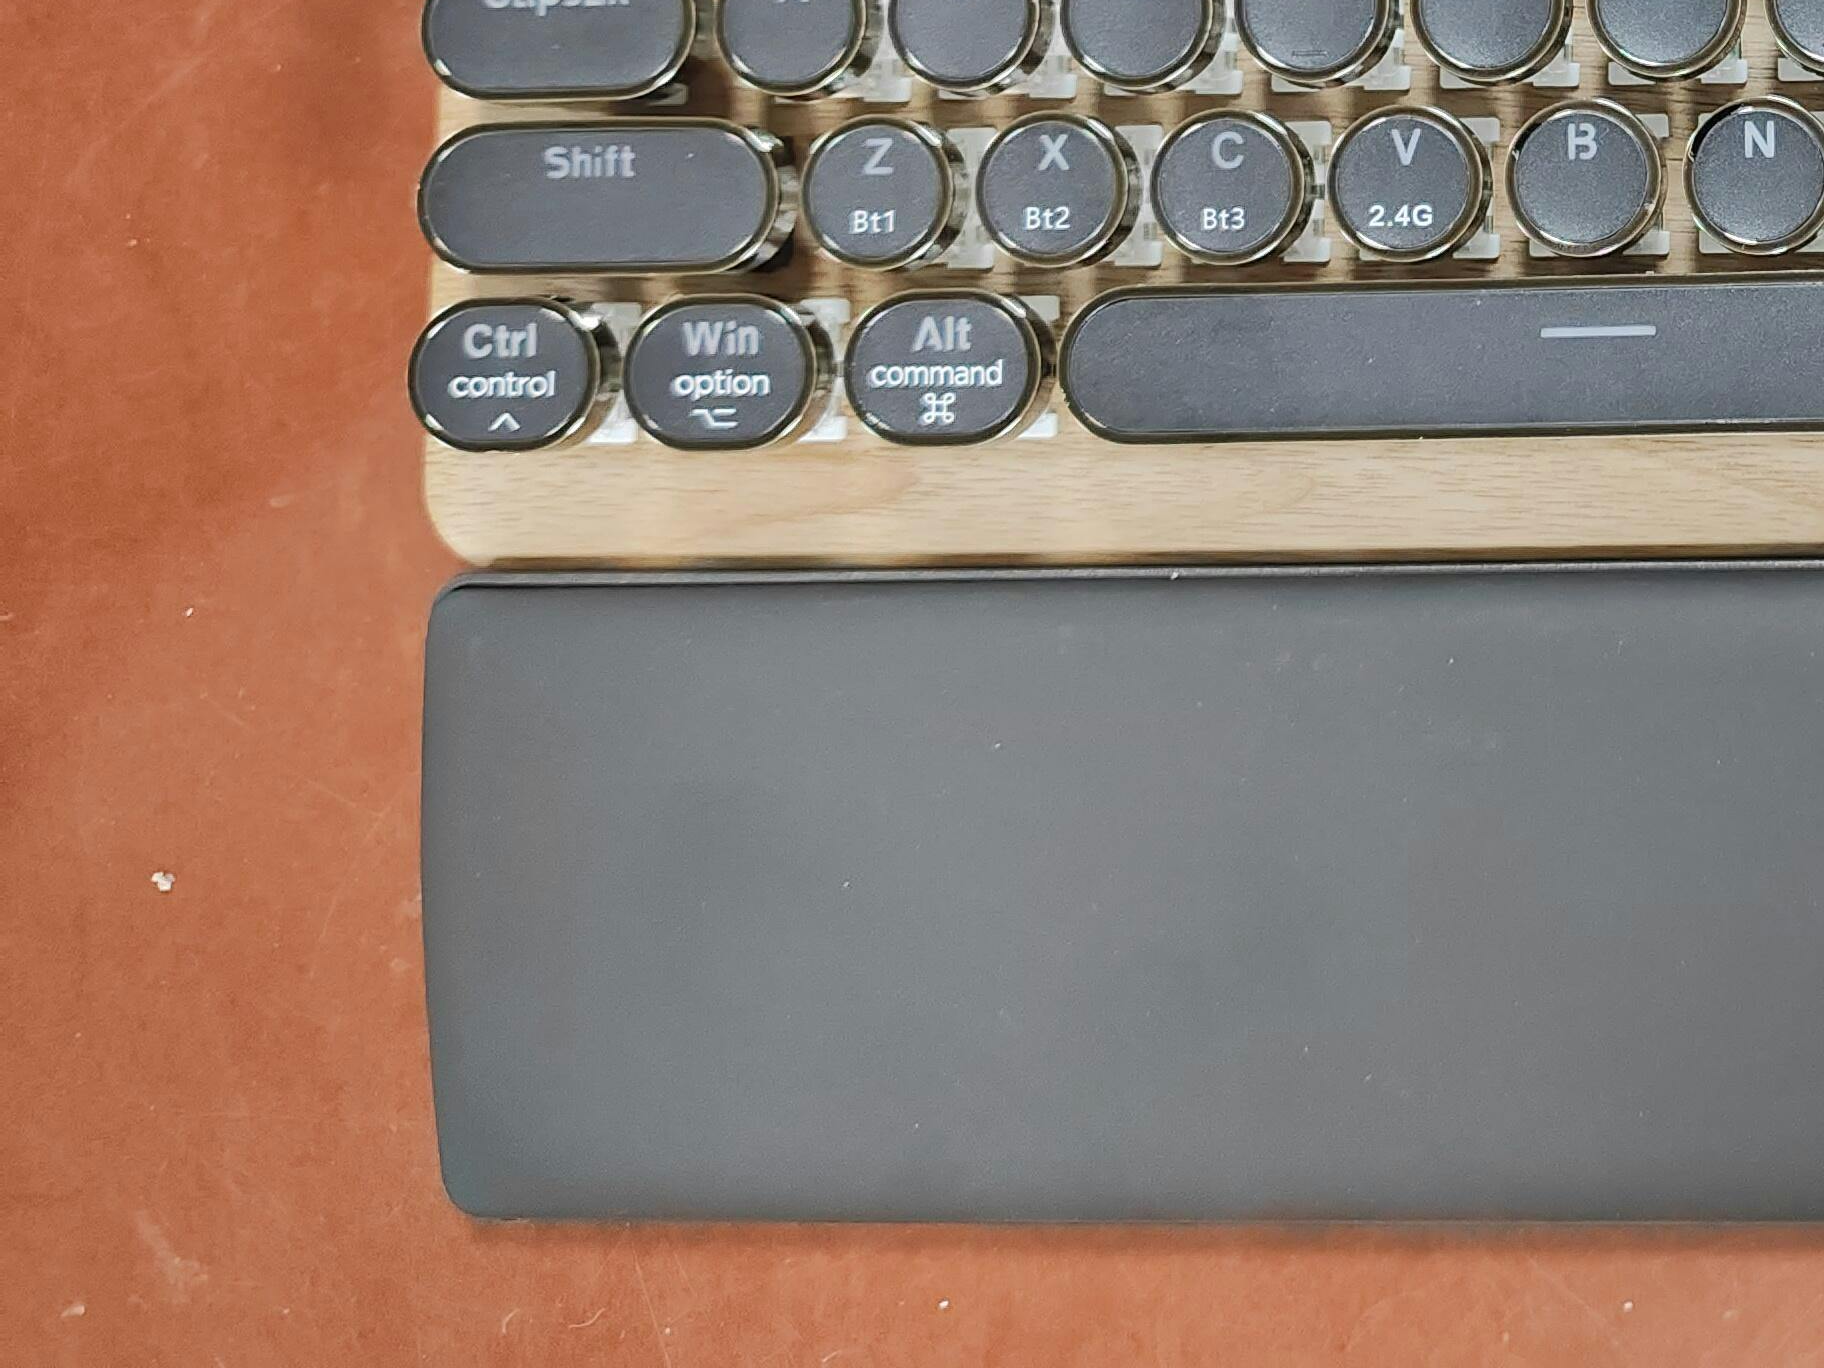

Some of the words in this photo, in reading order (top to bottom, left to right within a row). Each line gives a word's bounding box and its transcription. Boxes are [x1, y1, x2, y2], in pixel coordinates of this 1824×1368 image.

[864, 138, 893, 174] Z
[1039, 134, 1069, 170] X
[1212, 132, 1243, 169] C
[1391, 129, 1421, 165] V
[1568, 123, 1597, 160] B
[1745, 121, 1775, 158] N
[545, 146, 635, 178] Shift
[852, 210, 894, 233] Bt1
[1025, 206, 1070, 229] Bt2
[1202, 208, 1244, 230] Bt3
[1369, 205, 1432, 227] 2.4G
[464, 323, 536, 358] Ctrl
[683, 321, 759, 355] Win
[913, 316, 971, 351] Alt
[449, 371, 555, 397] control
[672, 369, 770, 400] option
[870, 359, 1003, 386] command
